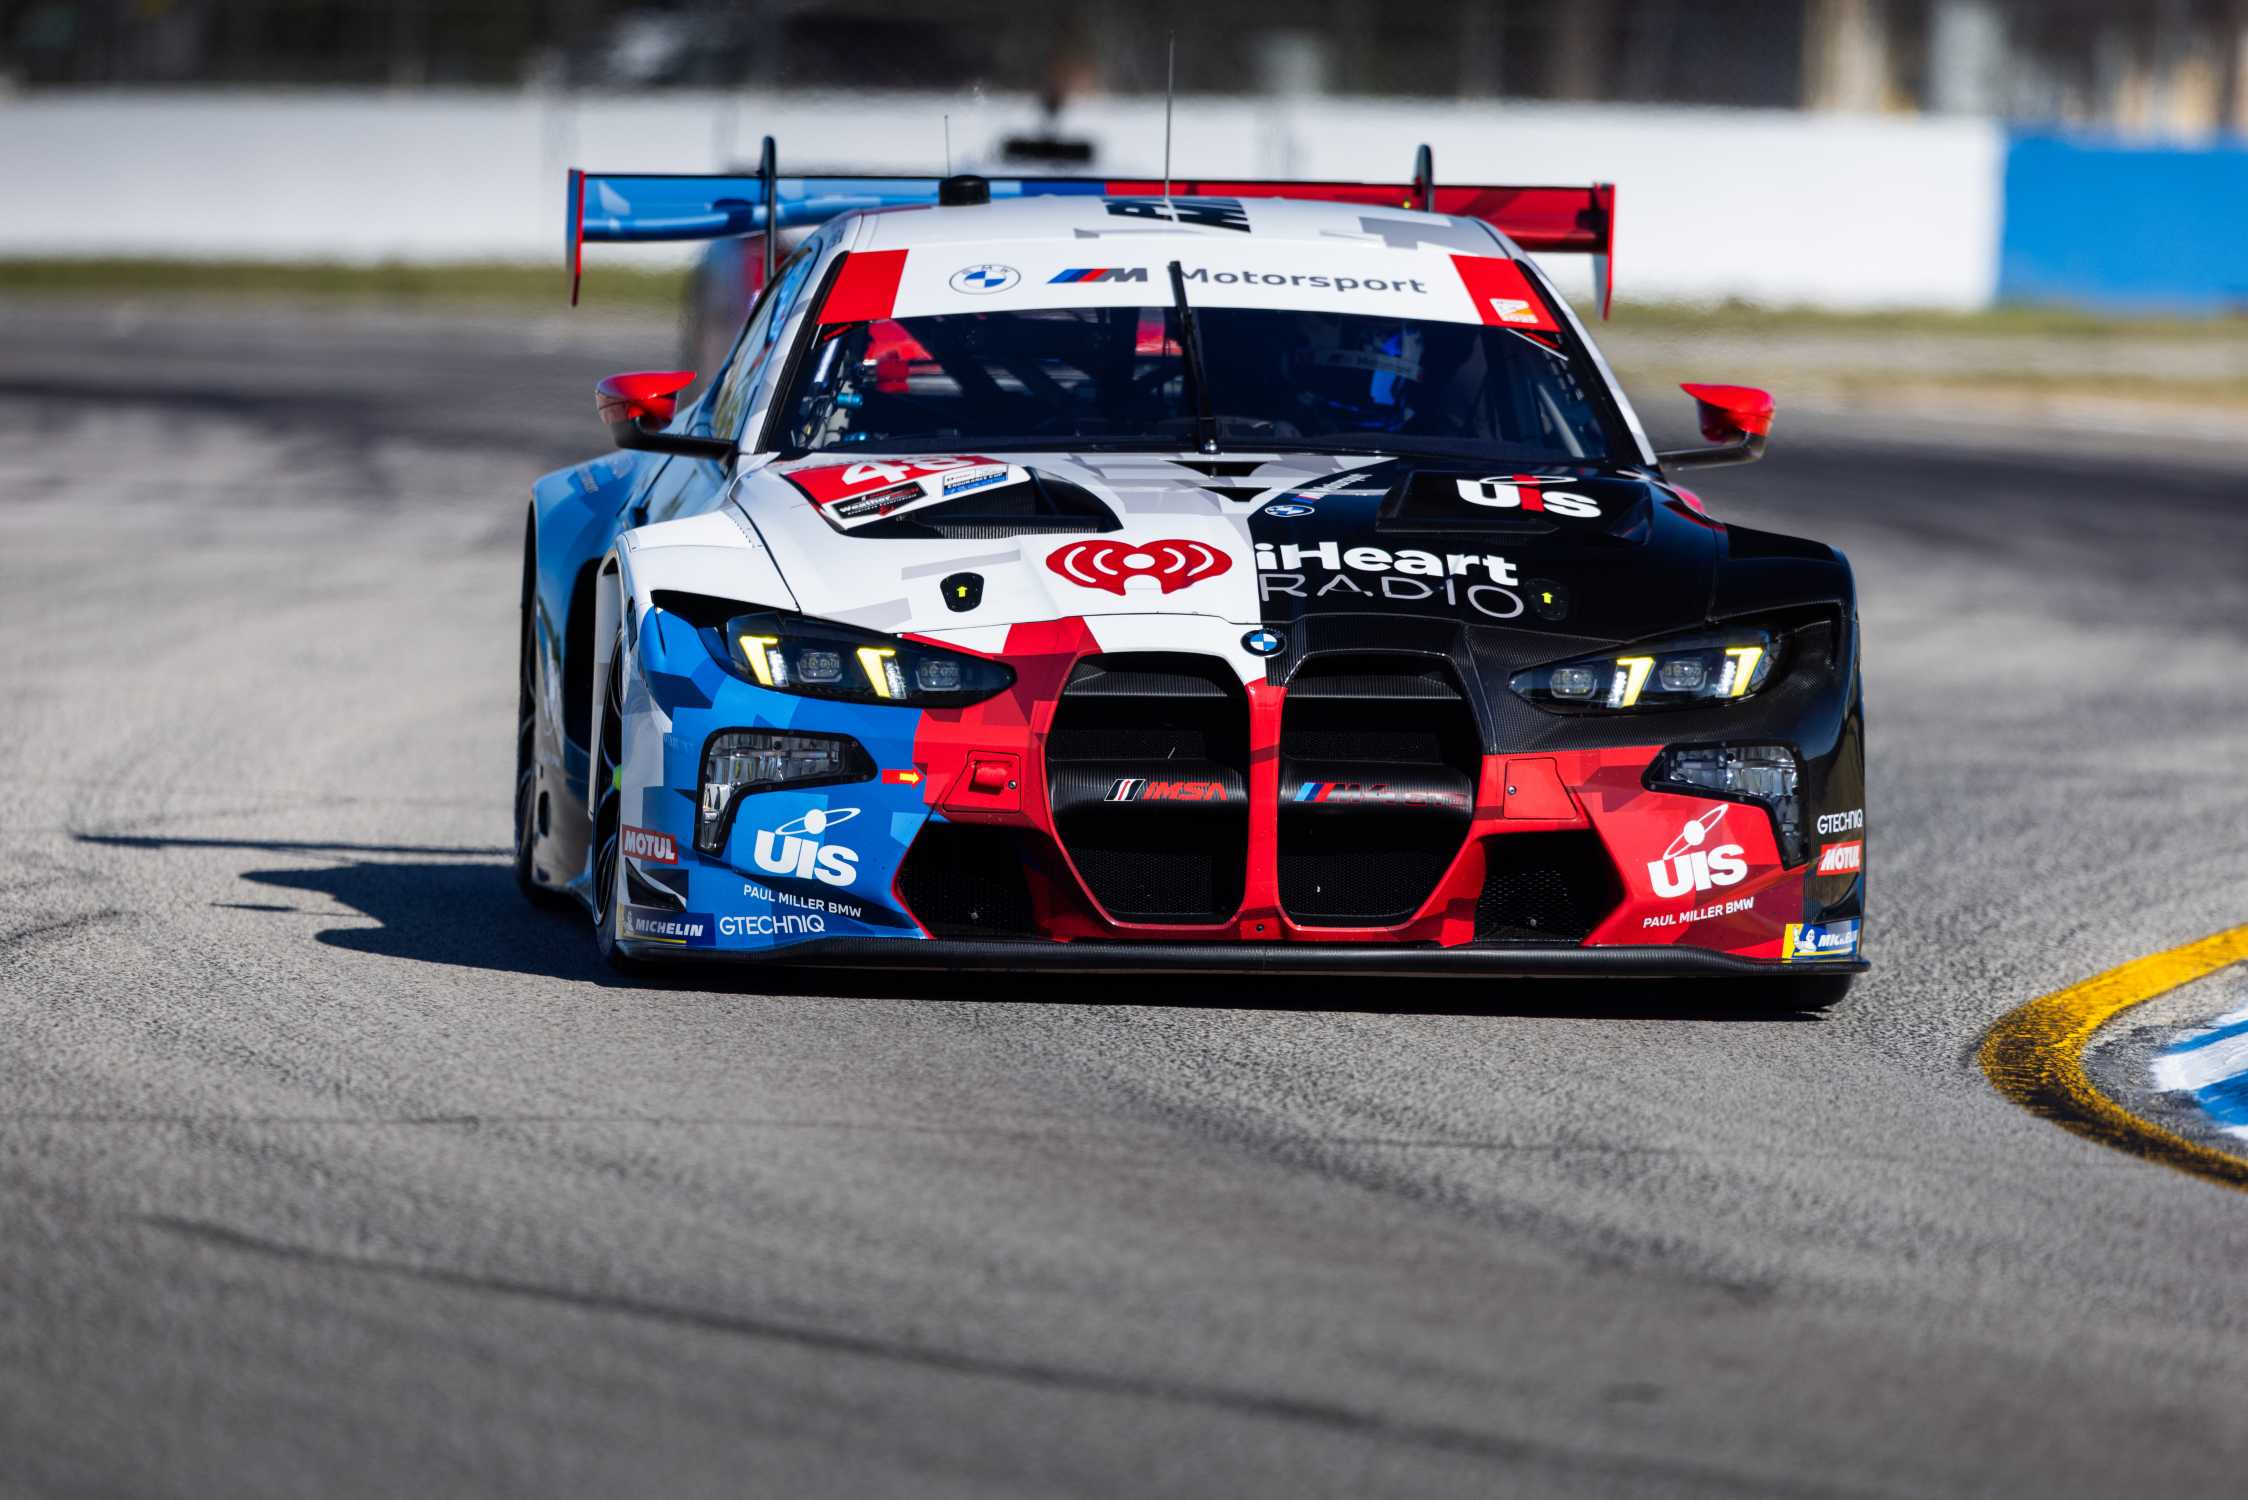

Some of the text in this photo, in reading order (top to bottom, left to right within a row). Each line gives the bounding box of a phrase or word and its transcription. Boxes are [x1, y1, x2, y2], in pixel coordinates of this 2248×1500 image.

[1181, 268, 1428, 294] Motorsport
[841, 456, 975, 485] 48
[1254, 541, 1519, 586] iHeart
[1259, 573, 1524, 619] RADIO
[1142, 781, 1228, 801] IMSA
[1816, 808, 1863, 834] GTECHNIQ
[624, 830, 675, 860] MOTUL
[1820, 845, 1860, 871] MOTUL
[743, 884, 862, 917] PAUL MILLER BMW
[1643, 896, 1755, 929] PAUL MILLER BMW
[635, 918, 704, 937] MICHELIN
[719, 914, 825, 936] GTECHNIQ
